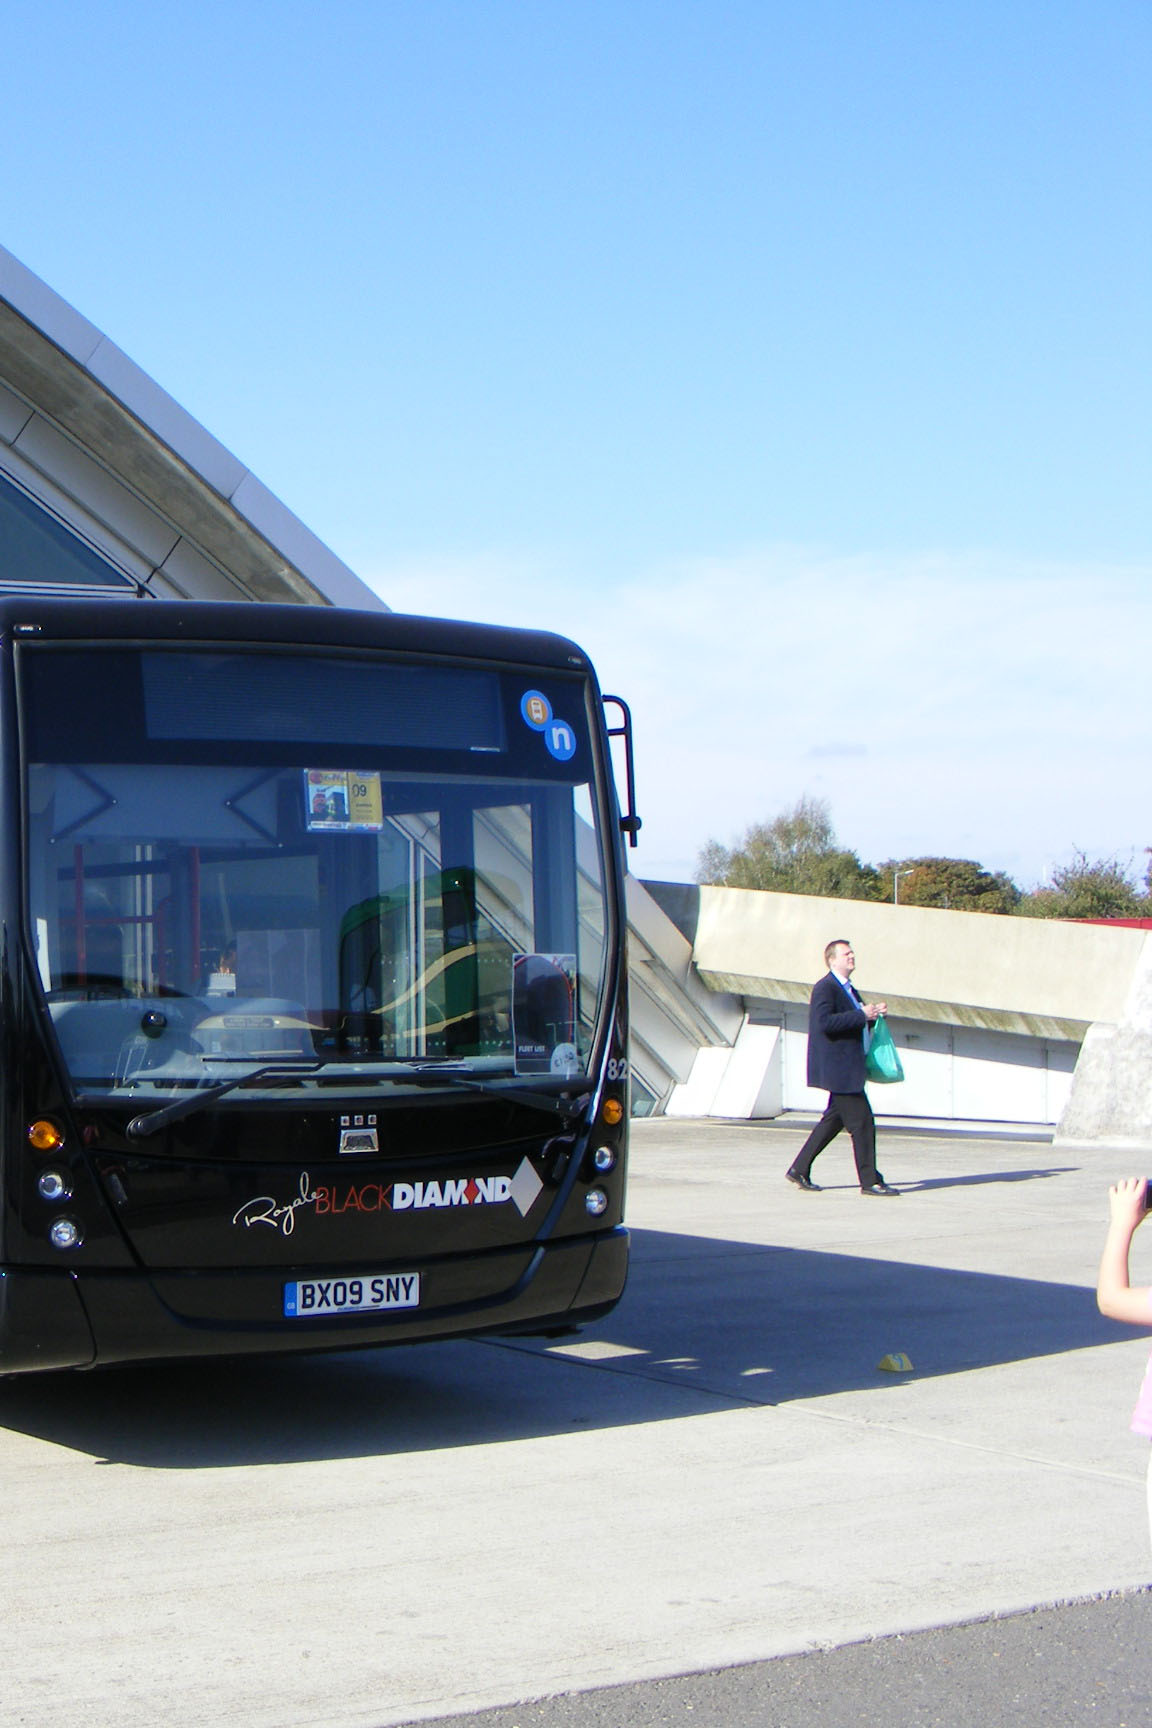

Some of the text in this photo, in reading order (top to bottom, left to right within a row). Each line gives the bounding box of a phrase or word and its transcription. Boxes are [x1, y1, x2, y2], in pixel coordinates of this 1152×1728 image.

[232, 1171, 323, 1236] Royale
[315, 1183, 393, 1214] BLACK
[301, 1275, 415, 1309] BX09 SNY
